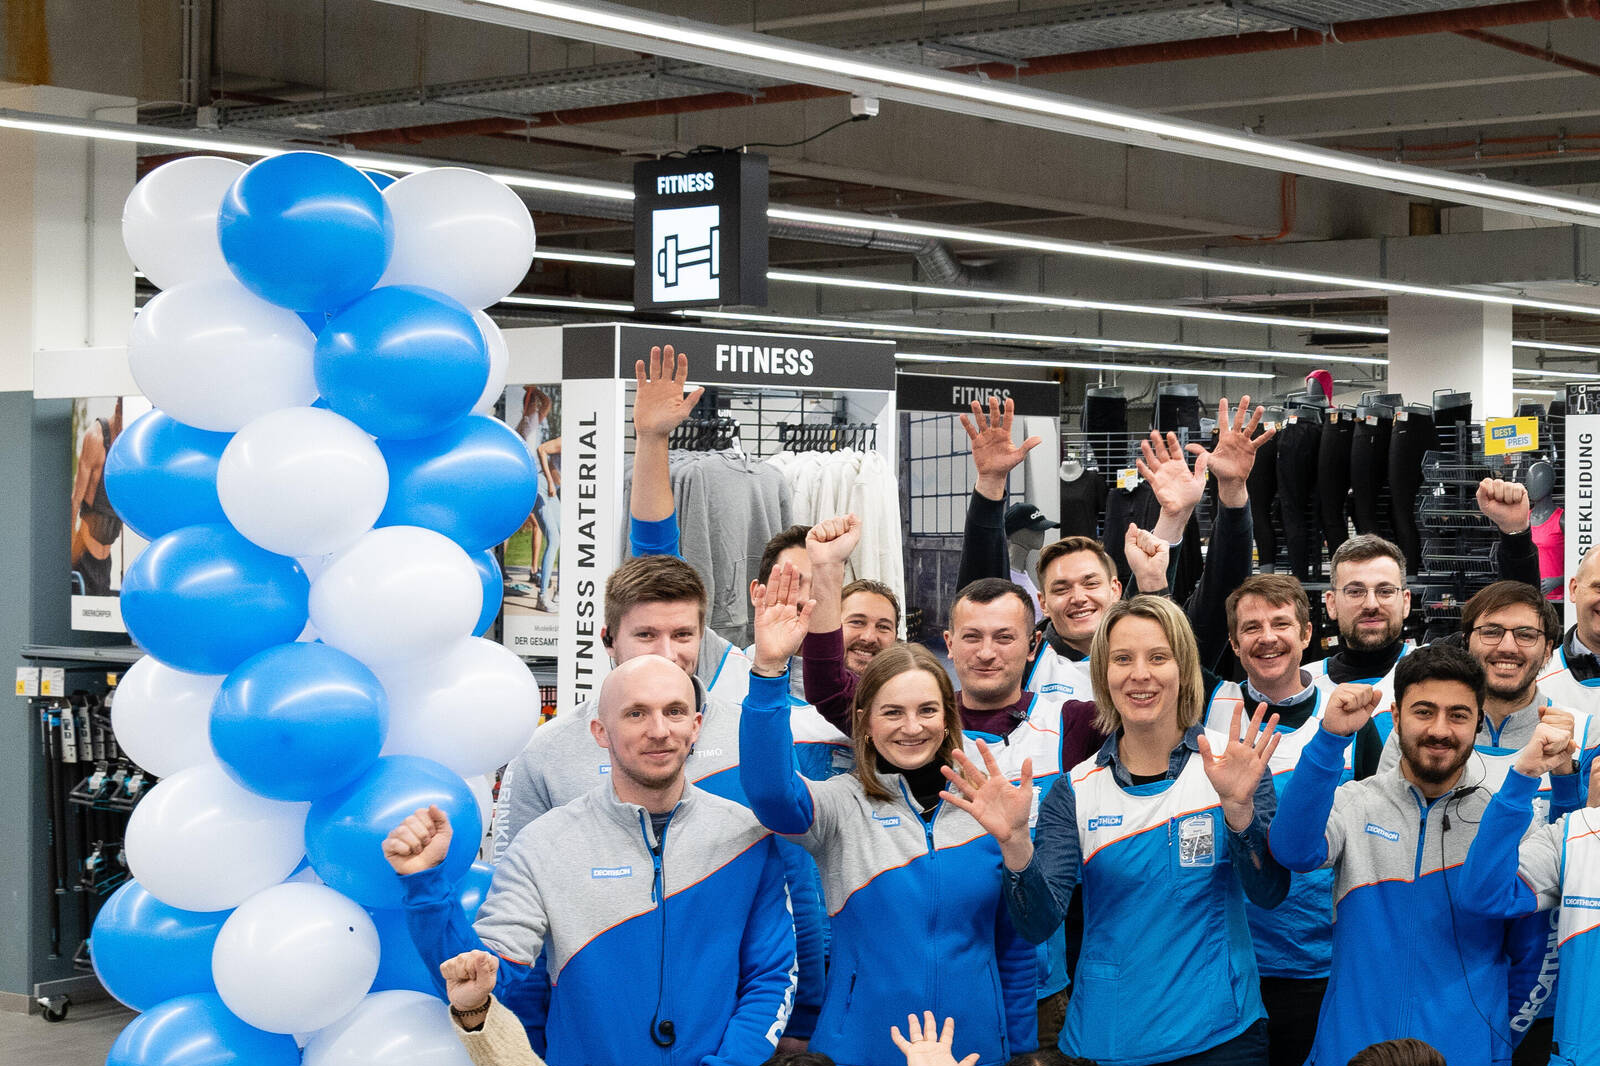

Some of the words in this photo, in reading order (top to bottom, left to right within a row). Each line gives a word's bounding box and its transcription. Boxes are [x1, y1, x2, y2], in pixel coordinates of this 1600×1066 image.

[657, 172, 714, 195] FITNESS
[716, 344, 814, 376] FITNESS
[953, 386, 1011, 406] FITNESS
[1493, 427, 1514, 437] BEST-
[1507, 436, 1529, 446] PREIS
[578, 412, 597, 568] MATERIAL
[1578, 433, 1592, 565] SBEKLEIDUNG
[514, 636, 528, 645] DER
[530, 637, 558, 647] GESAMT
[575, 580, 594, 706] FITNESS
[1090, 816, 1121, 830] DTHLON
[1565, 897, 1600, 907] DECATHLON
[1509, 906, 1561, 1032] DECATHLO
